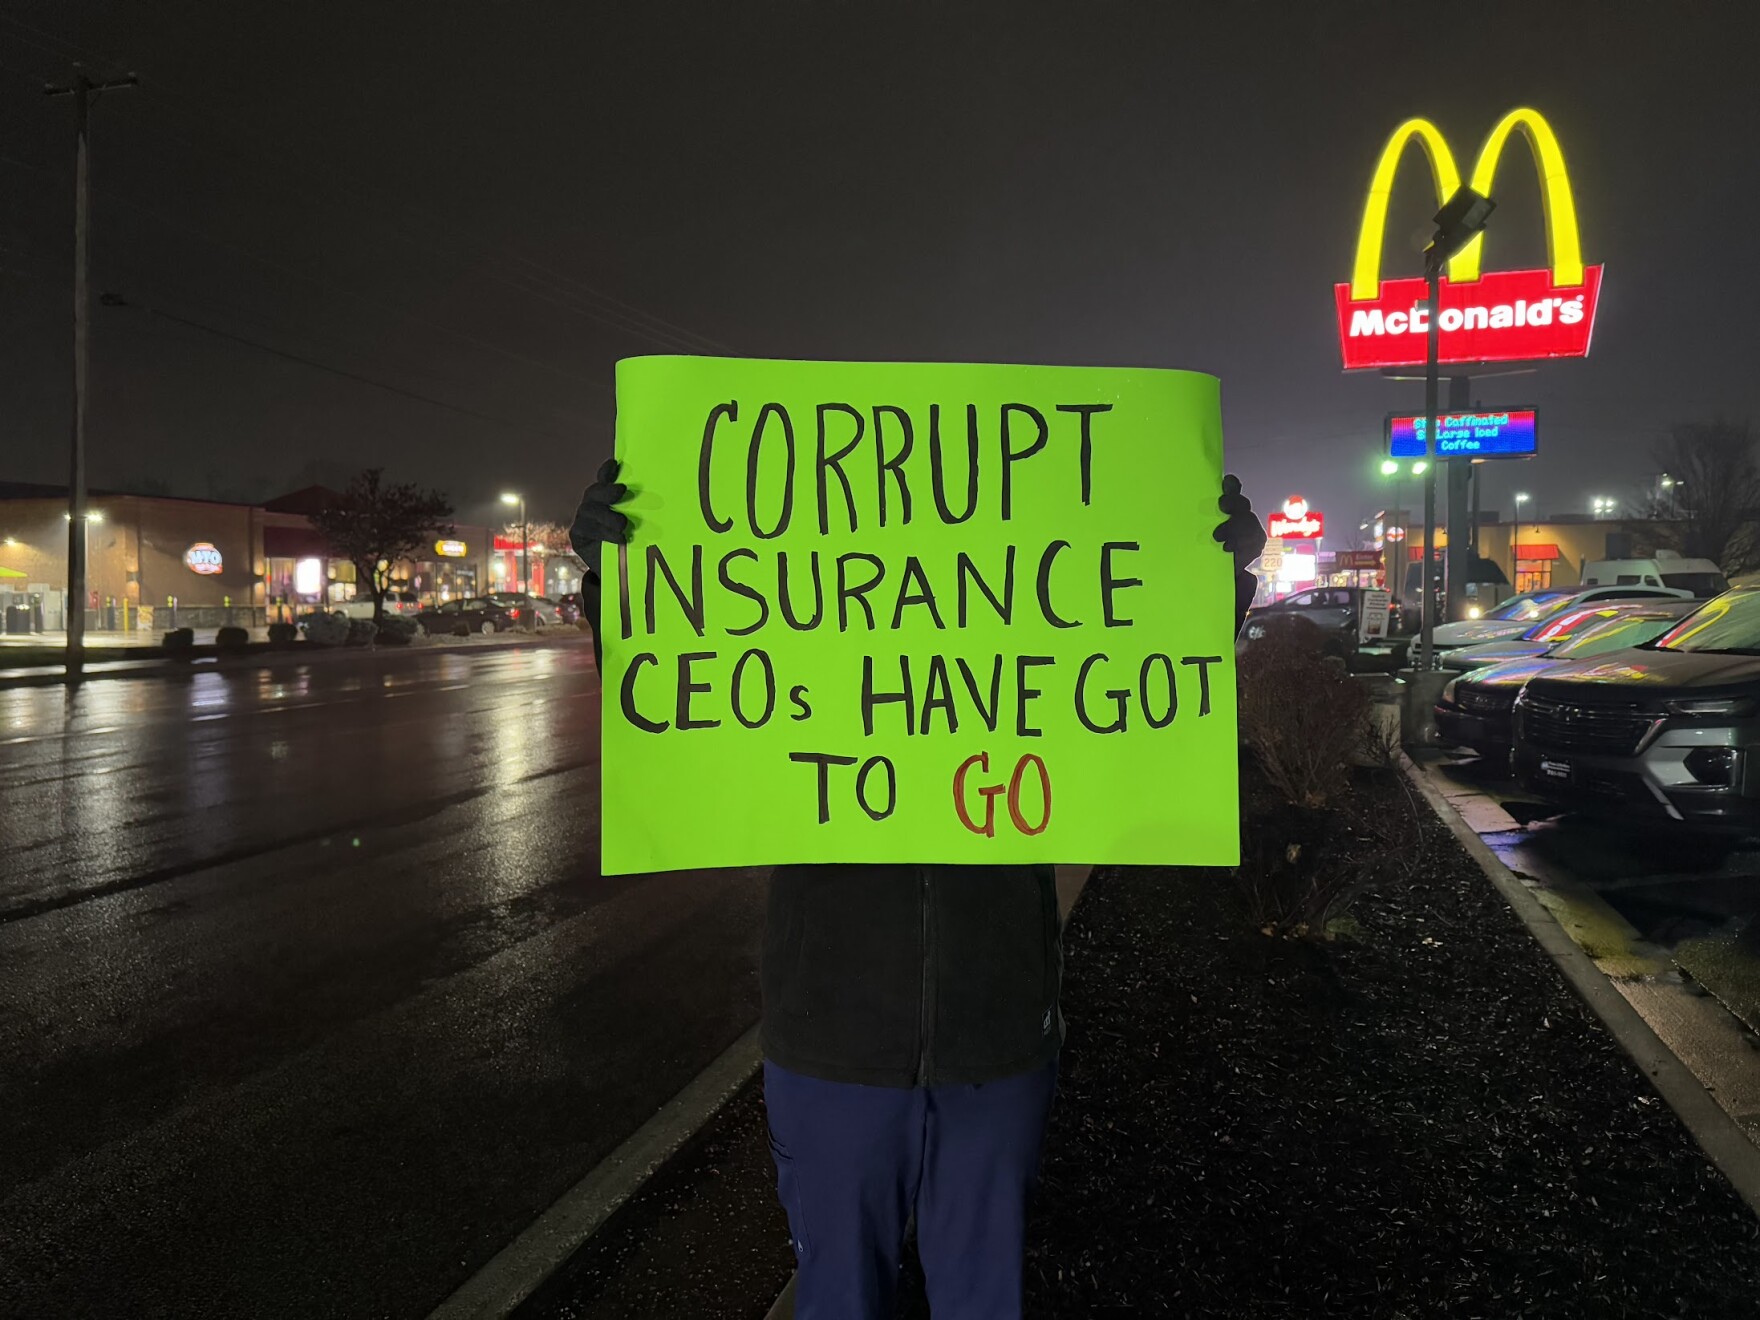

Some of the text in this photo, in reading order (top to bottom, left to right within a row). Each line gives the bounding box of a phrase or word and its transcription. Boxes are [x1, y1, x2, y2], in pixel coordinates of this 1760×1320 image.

[1350, 297, 1584, 337] McDonald's
[1436, 428, 1471, 440] Large
[1441, 440, 1480, 451] Coffee
[698, 400, 1114, 540] CORRUPT
[617, 539, 1144, 640] INSURANCE
[1264, 557, 1283, 568] 220
[619, 649, 1223, 738] CEOs HAVE GOT
[789, 750, 1053, 839] TO GO
